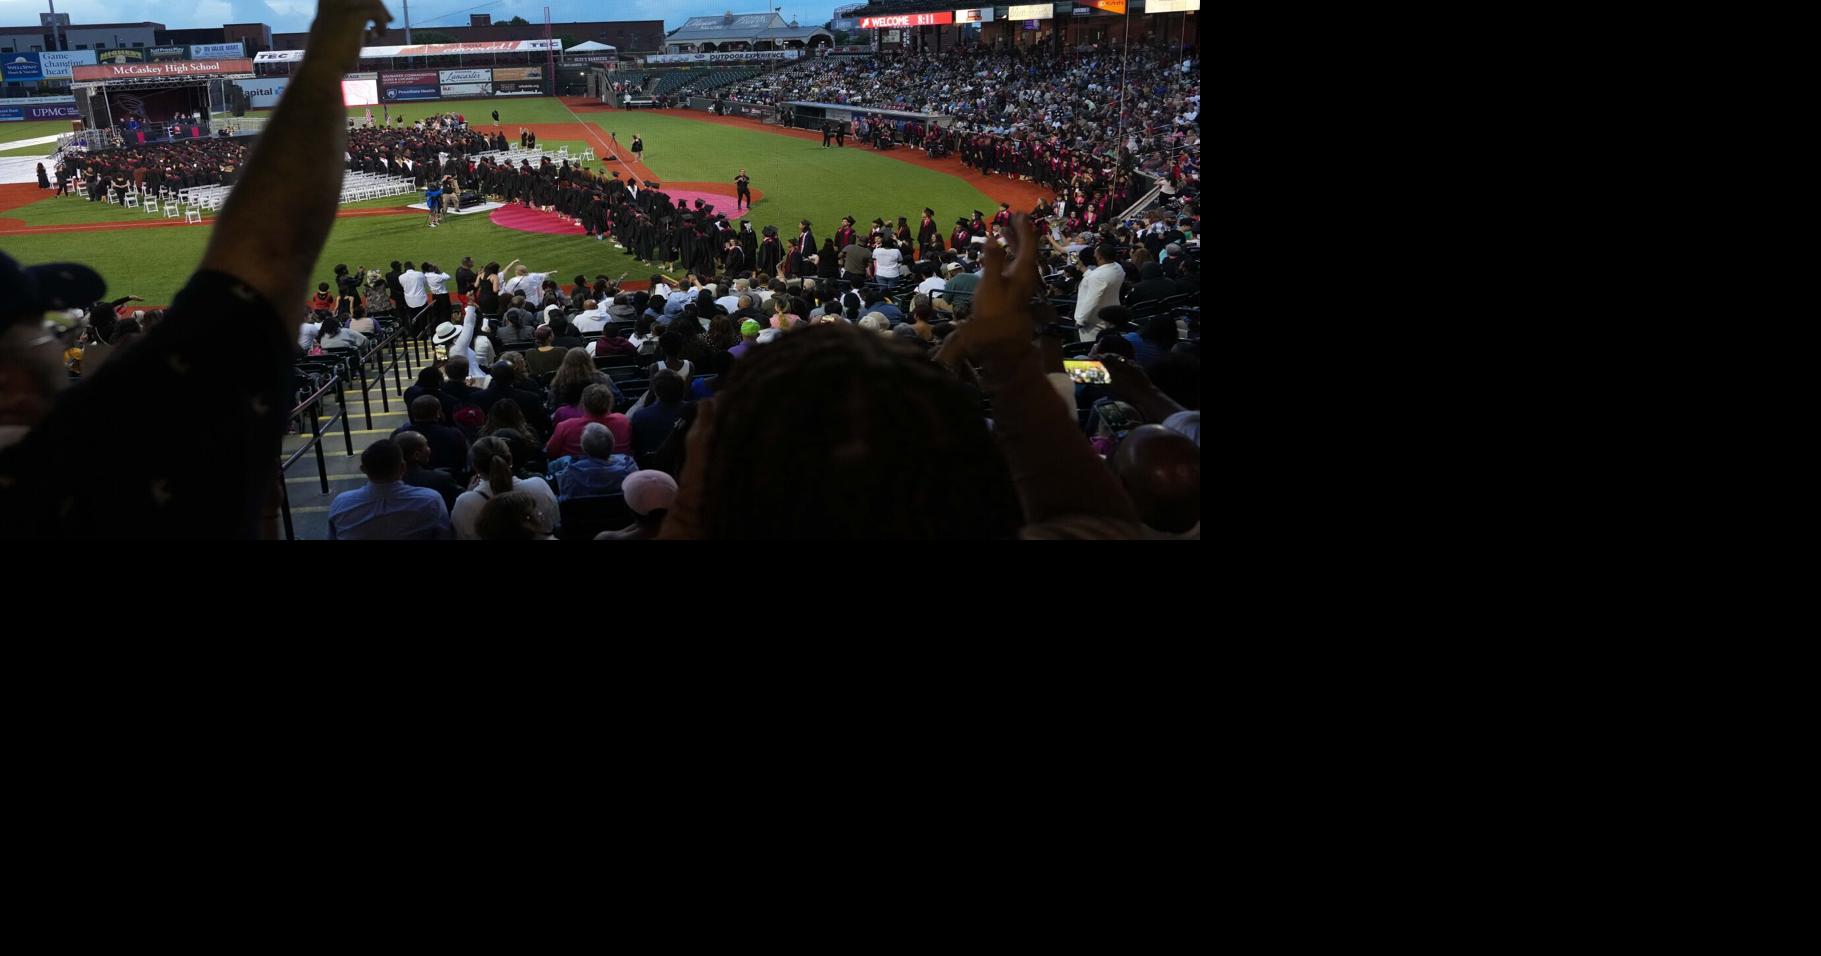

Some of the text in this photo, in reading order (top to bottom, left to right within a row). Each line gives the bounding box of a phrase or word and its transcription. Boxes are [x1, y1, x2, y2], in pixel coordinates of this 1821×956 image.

[872, 14, 934, 26] WELCOME 8:11
[113, 62, 220, 75] McCaskey High School
[446, 71, 480, 81] Lancaster
[244, 87, 273, 97] apital
[32, 107, 67, 117] UPMC
